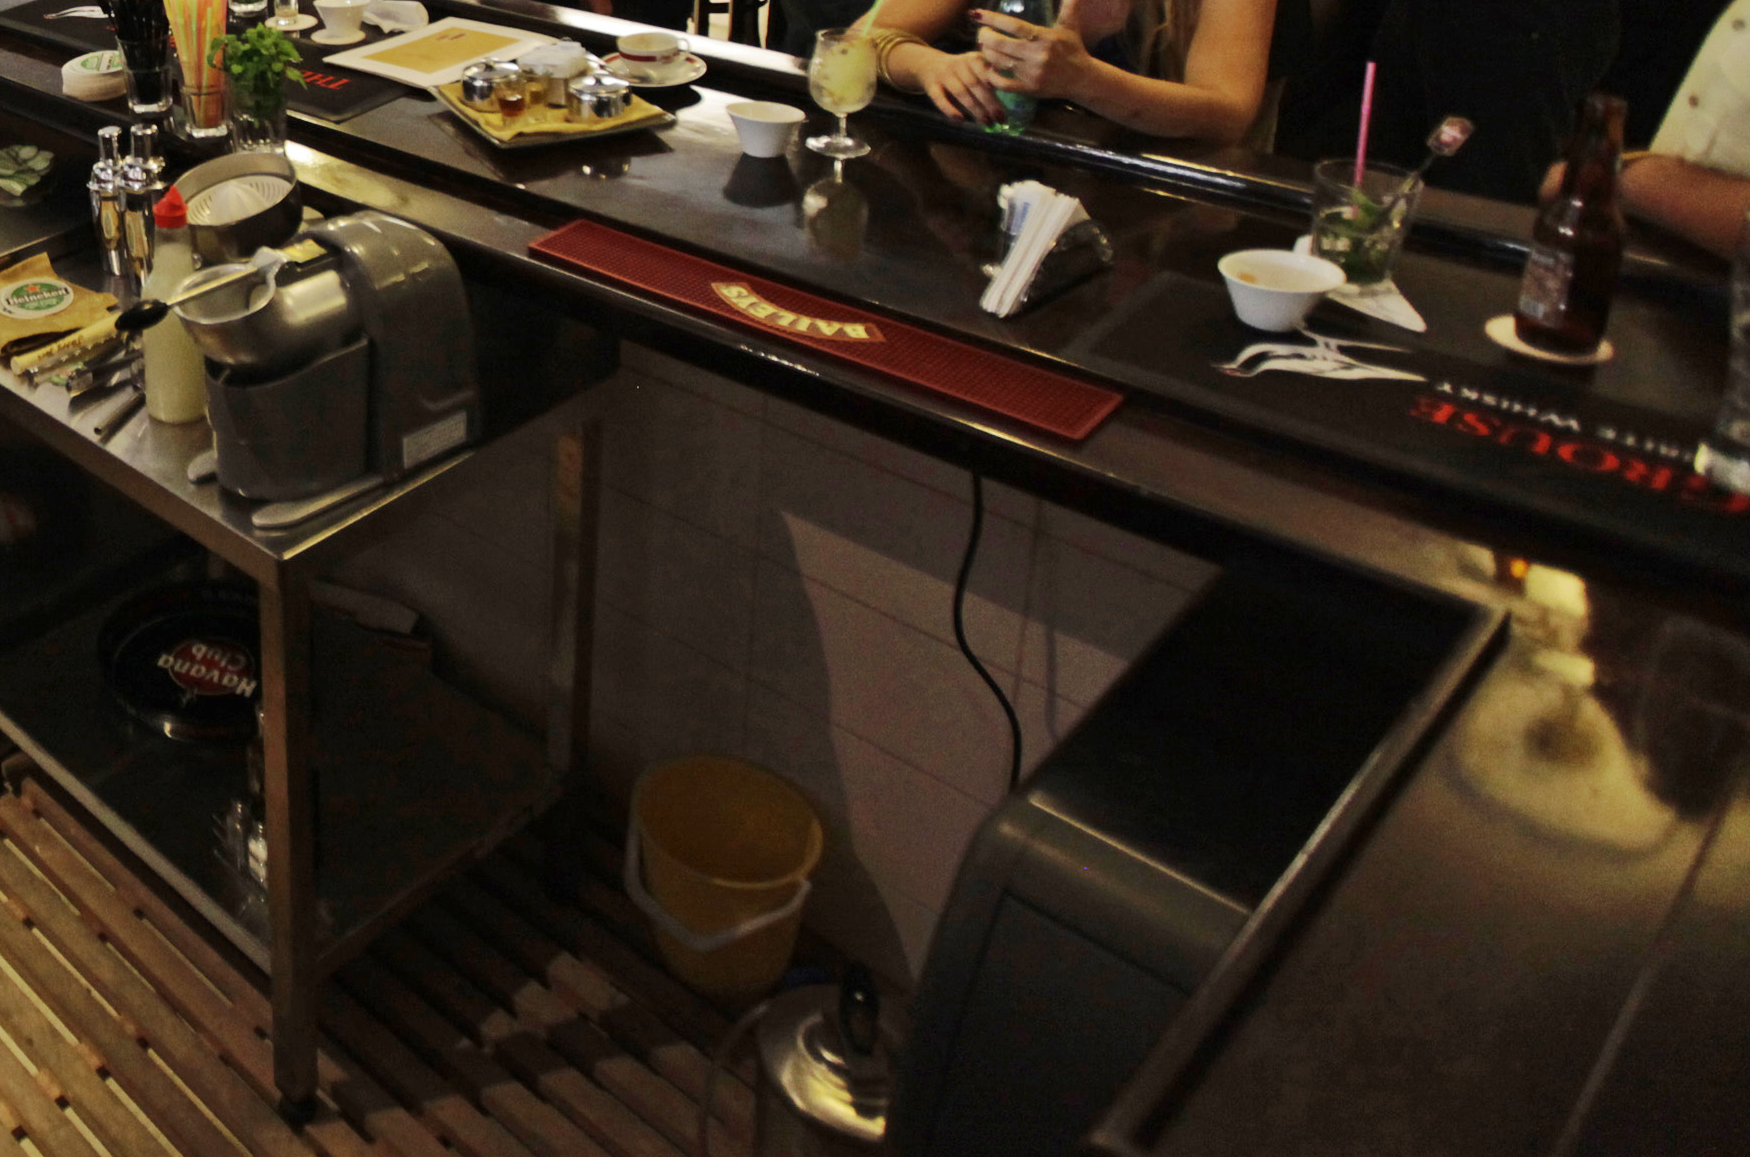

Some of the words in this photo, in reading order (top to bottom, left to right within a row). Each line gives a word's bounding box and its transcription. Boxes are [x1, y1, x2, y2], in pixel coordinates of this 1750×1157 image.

[8, 288, 68, 306] Heineken
[720, 285, 871, 339] BAILEYS
[156, 653, 258, 698] Havana
[192, 642, 249, 672] Club
